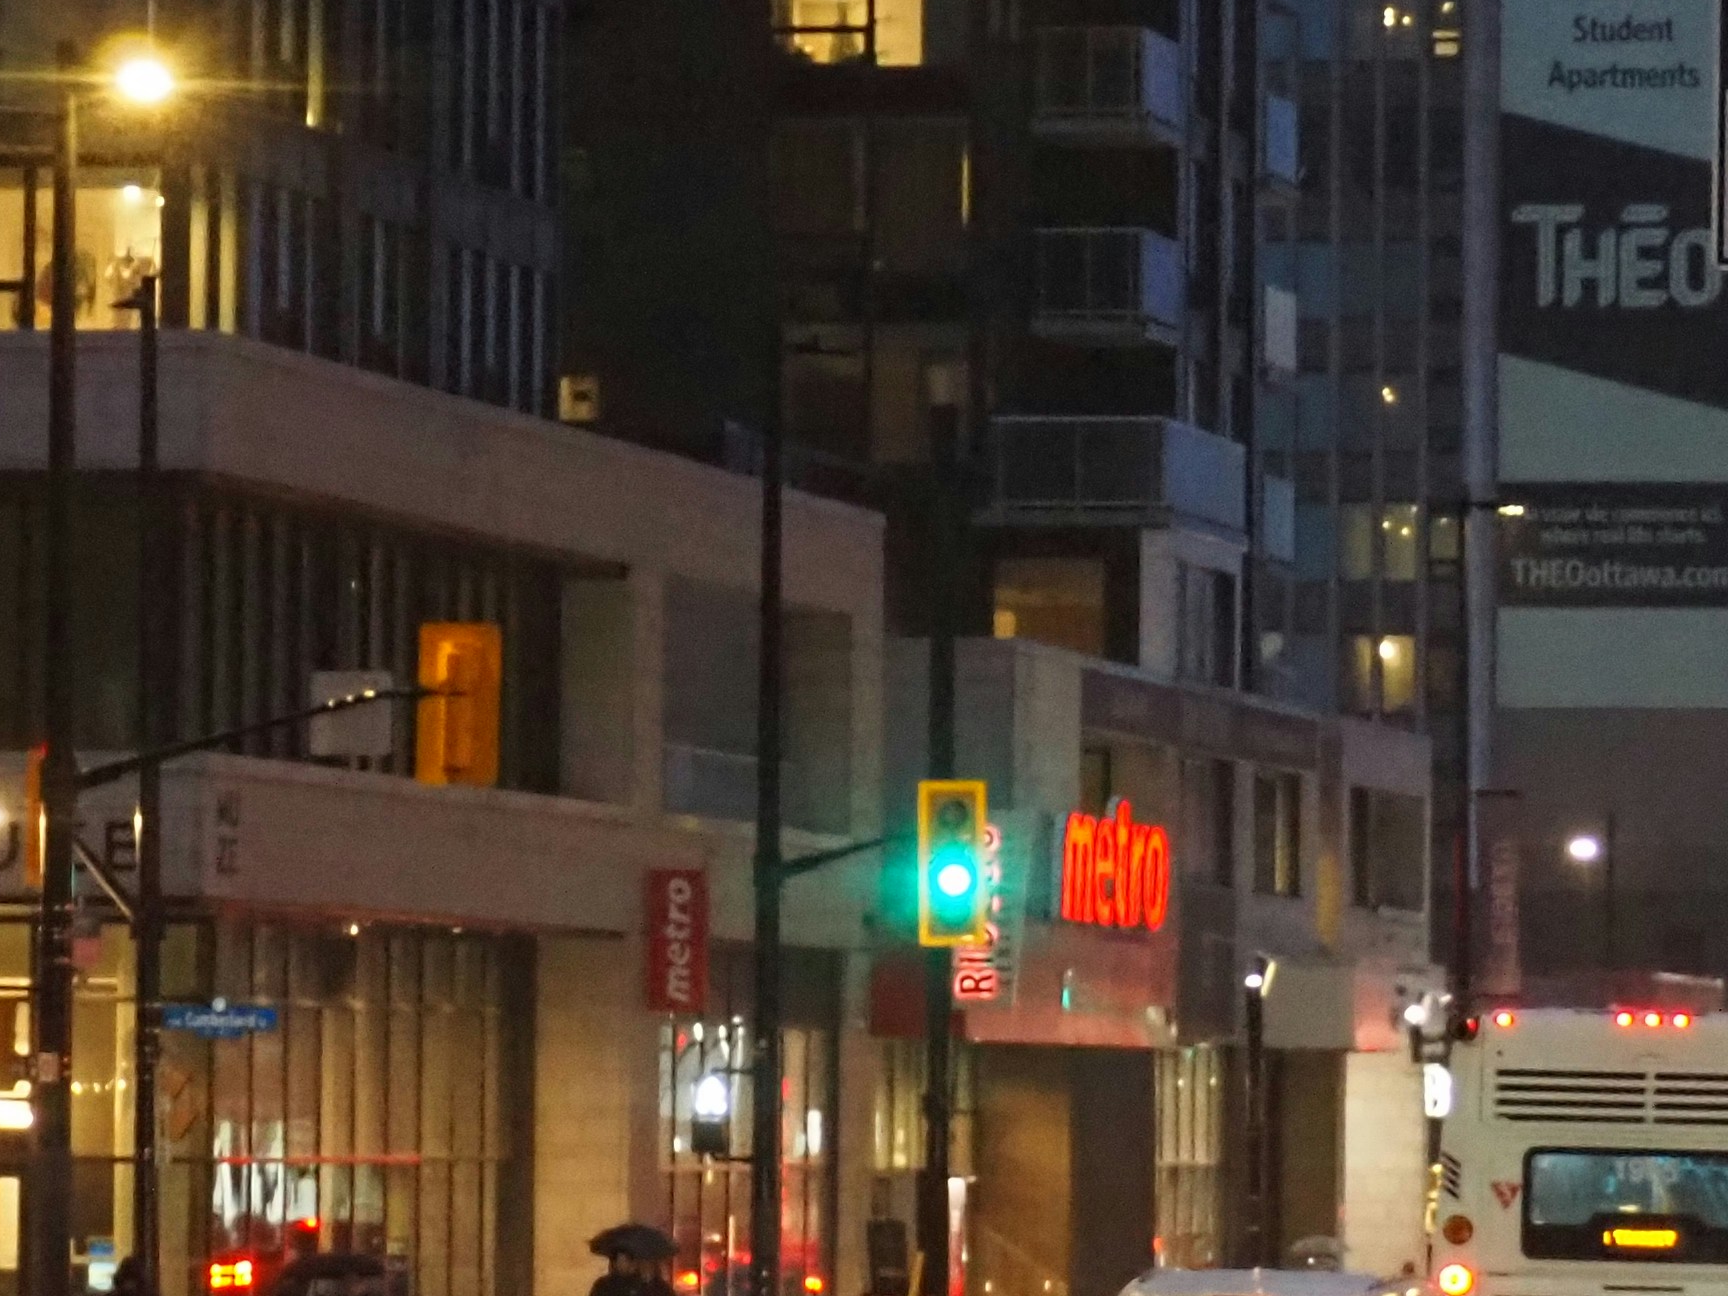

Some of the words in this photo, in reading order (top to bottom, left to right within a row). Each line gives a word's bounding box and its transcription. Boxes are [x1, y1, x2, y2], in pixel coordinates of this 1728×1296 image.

[1573, 14, 1674, 44] Student
[1548, 59, 1701, 95] Apartments
[1063, 800, 1169, 933] metro
[665, 875, 693, 1004] metro
